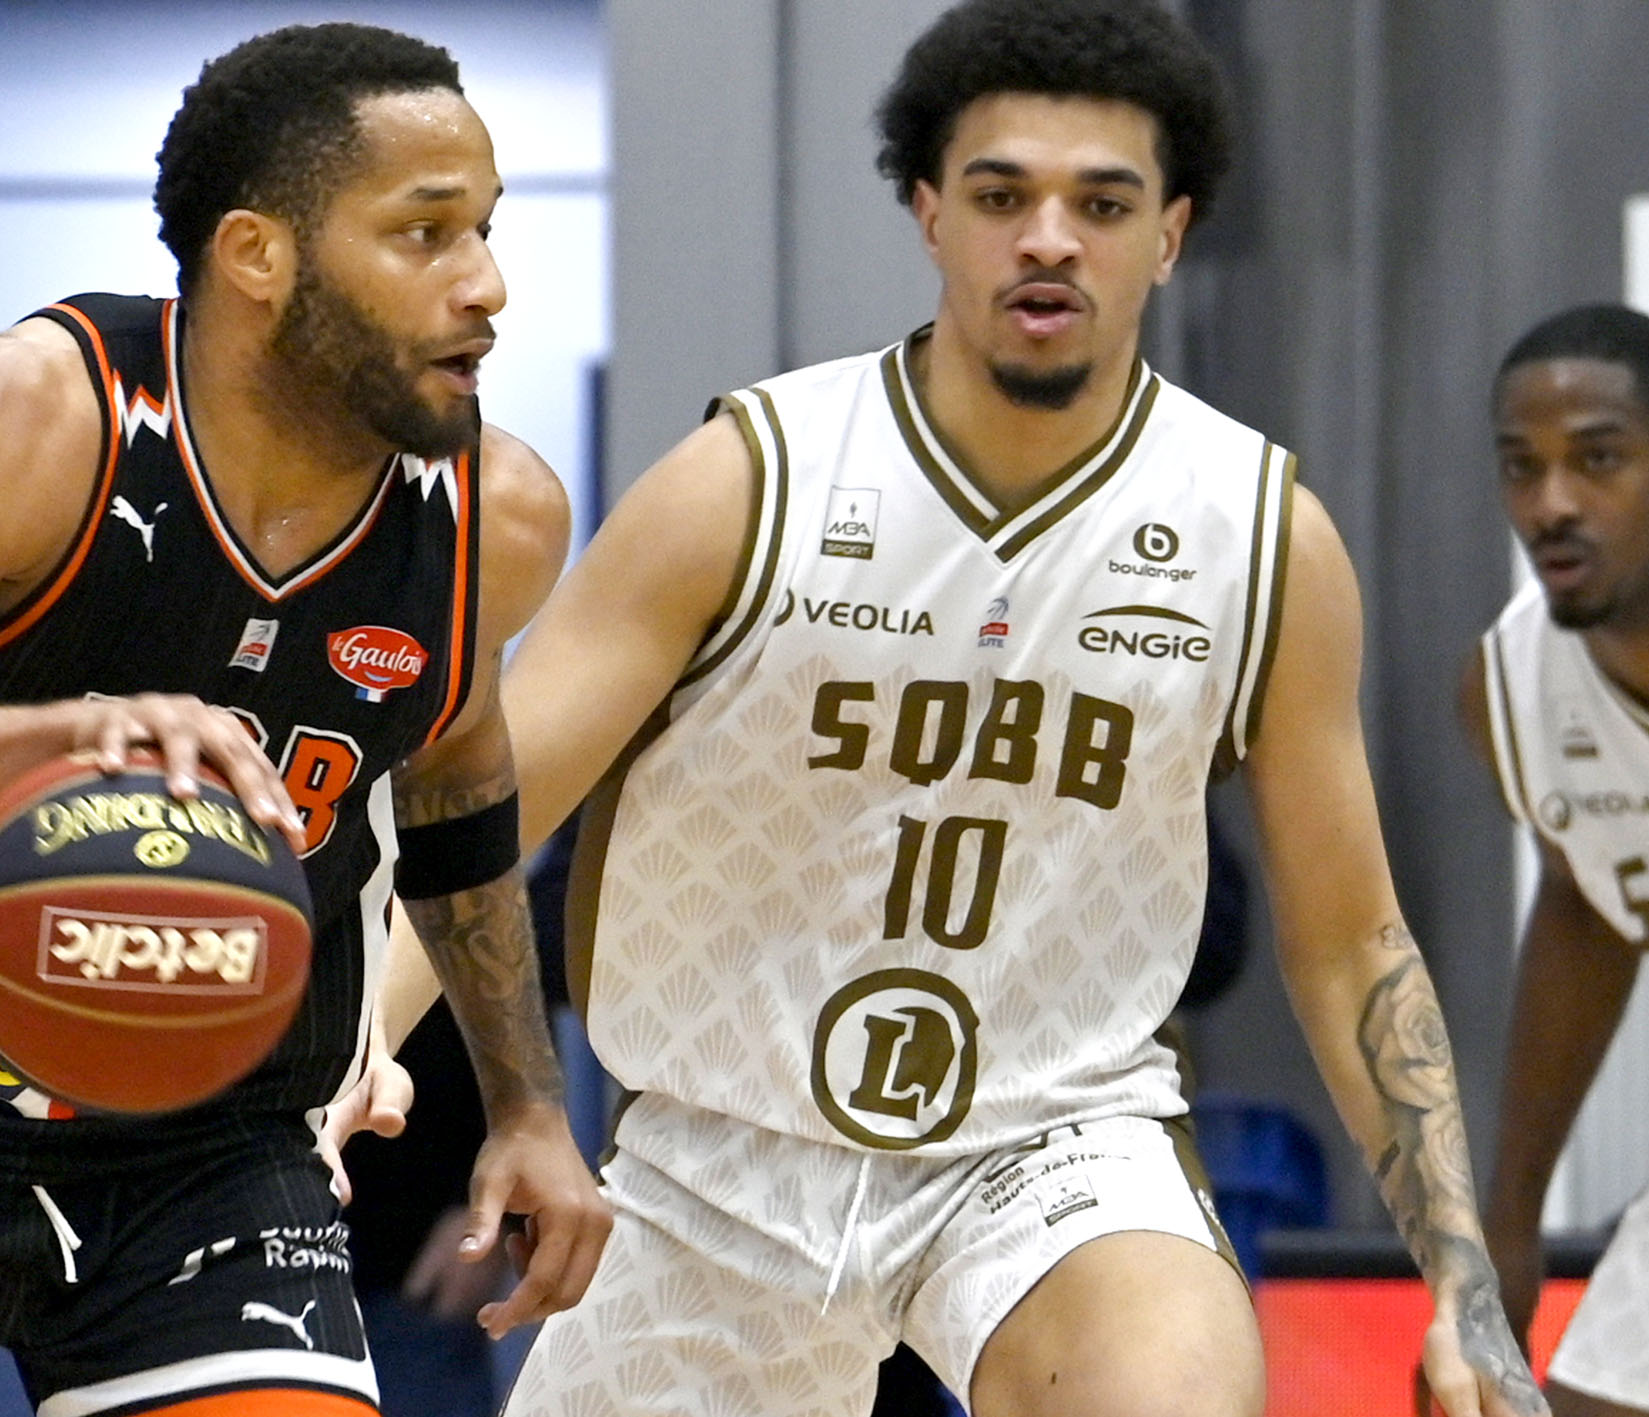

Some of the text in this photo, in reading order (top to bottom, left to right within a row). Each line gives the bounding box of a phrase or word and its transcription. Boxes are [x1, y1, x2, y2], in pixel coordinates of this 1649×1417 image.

[1109, 559, 1197, 582] boulanger
[803, 597, 934, 636] VEOLIA
[338, 632, 423, 677] Gaulois
[807, 677, 1135, 811] SQBB
[882, 813, 1009, 951] 10
[48, 918, 260, 985] Betclic
